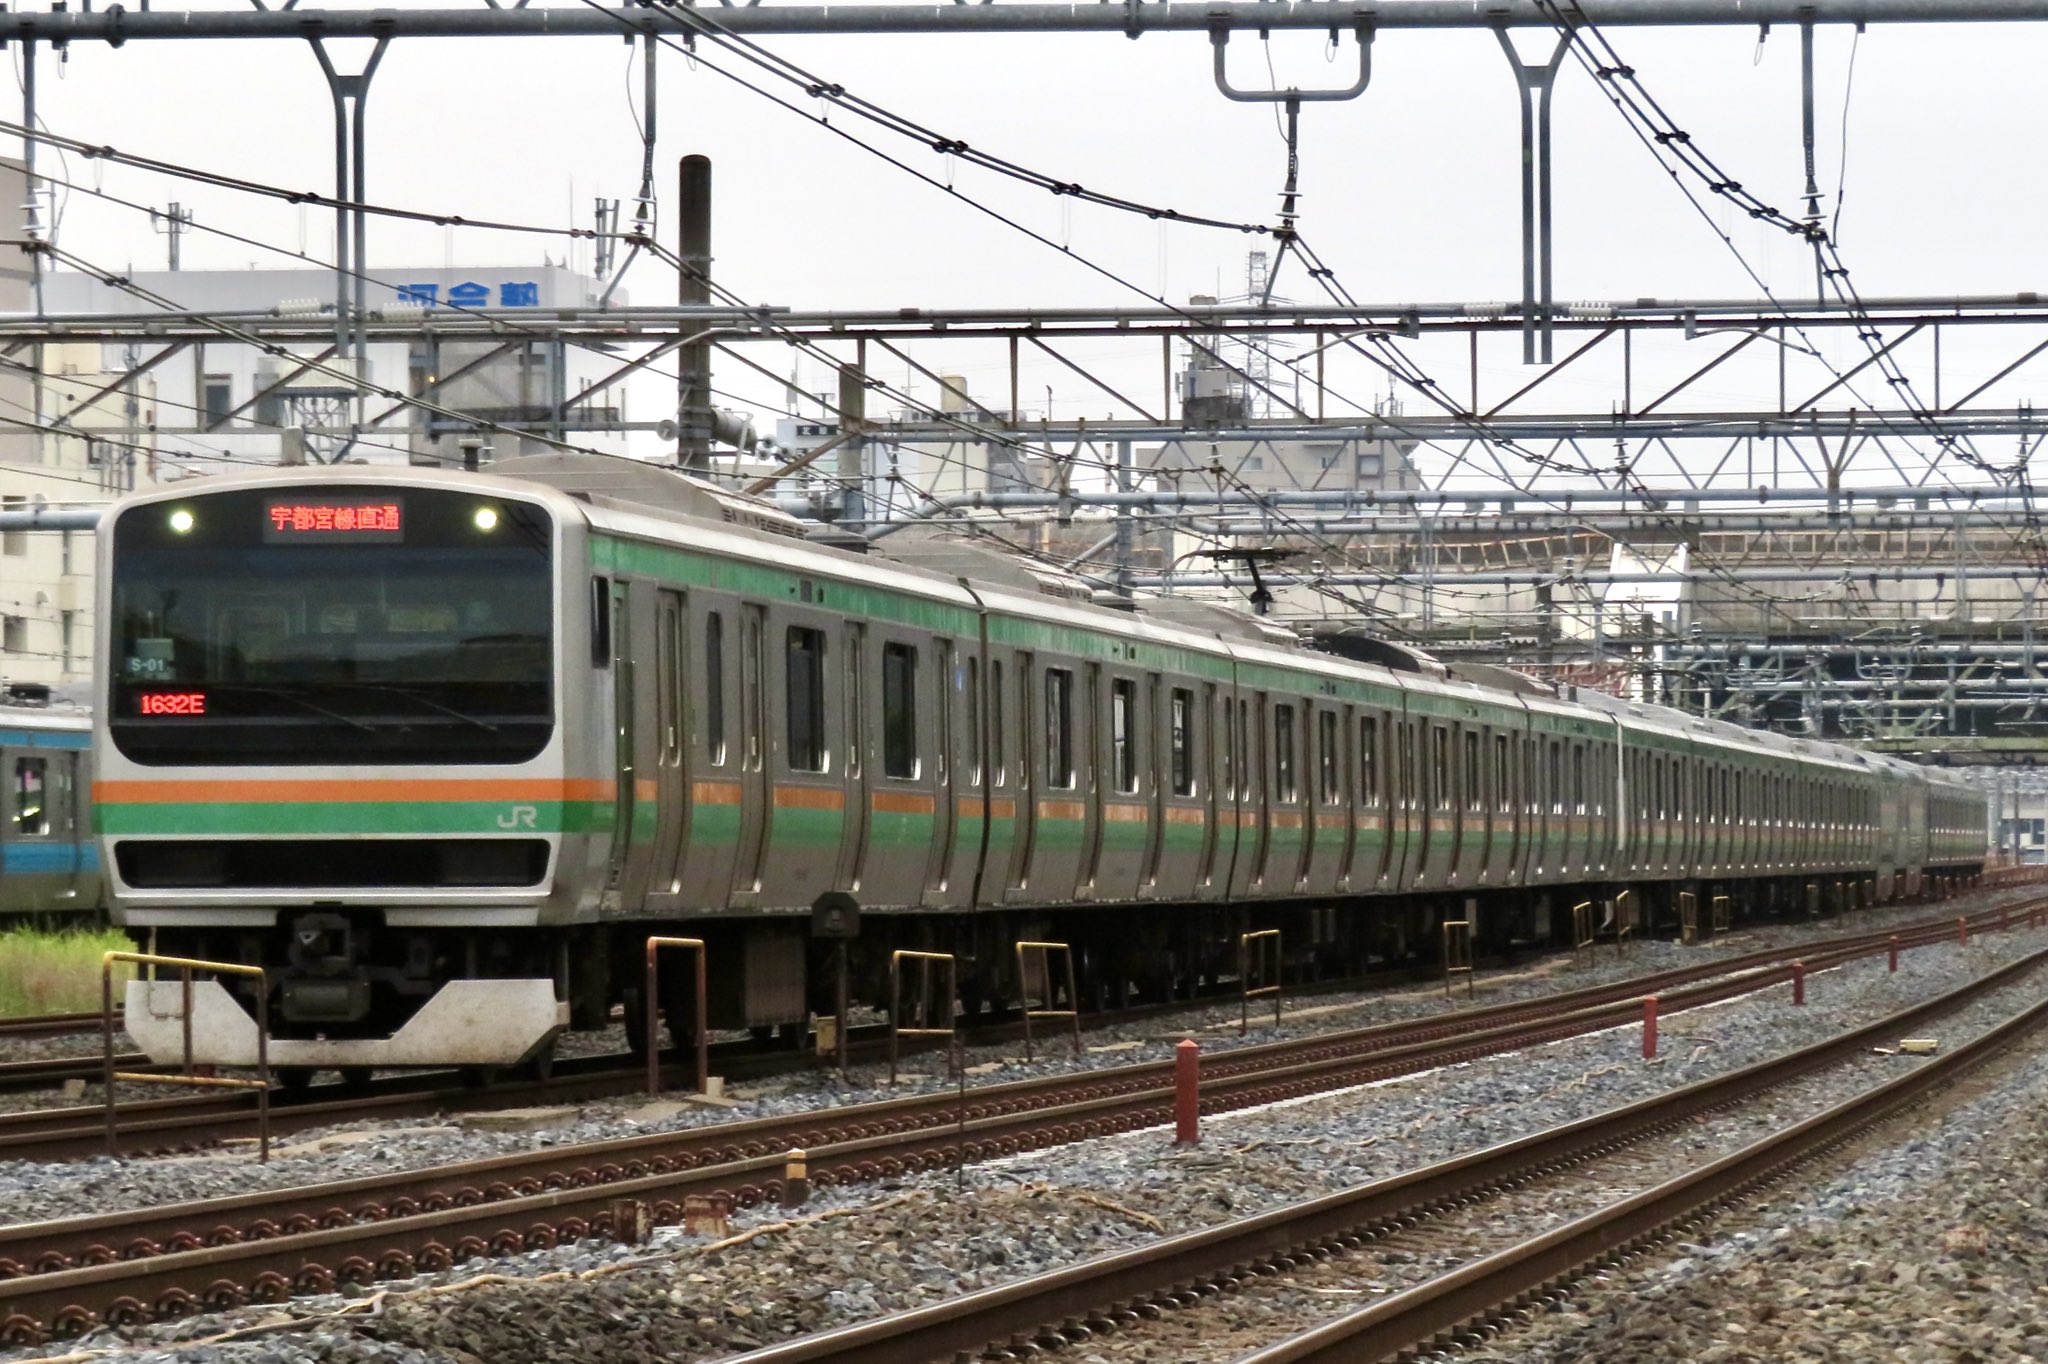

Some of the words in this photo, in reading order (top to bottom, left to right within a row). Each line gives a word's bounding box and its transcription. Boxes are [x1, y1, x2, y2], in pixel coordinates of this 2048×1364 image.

[271, 505, 400, 531] 宇都宮線直通
[131, 658, 165, 671] S-01
[141, 694, 205, 714] 1632E
[497, 805, 537, 828] JR
